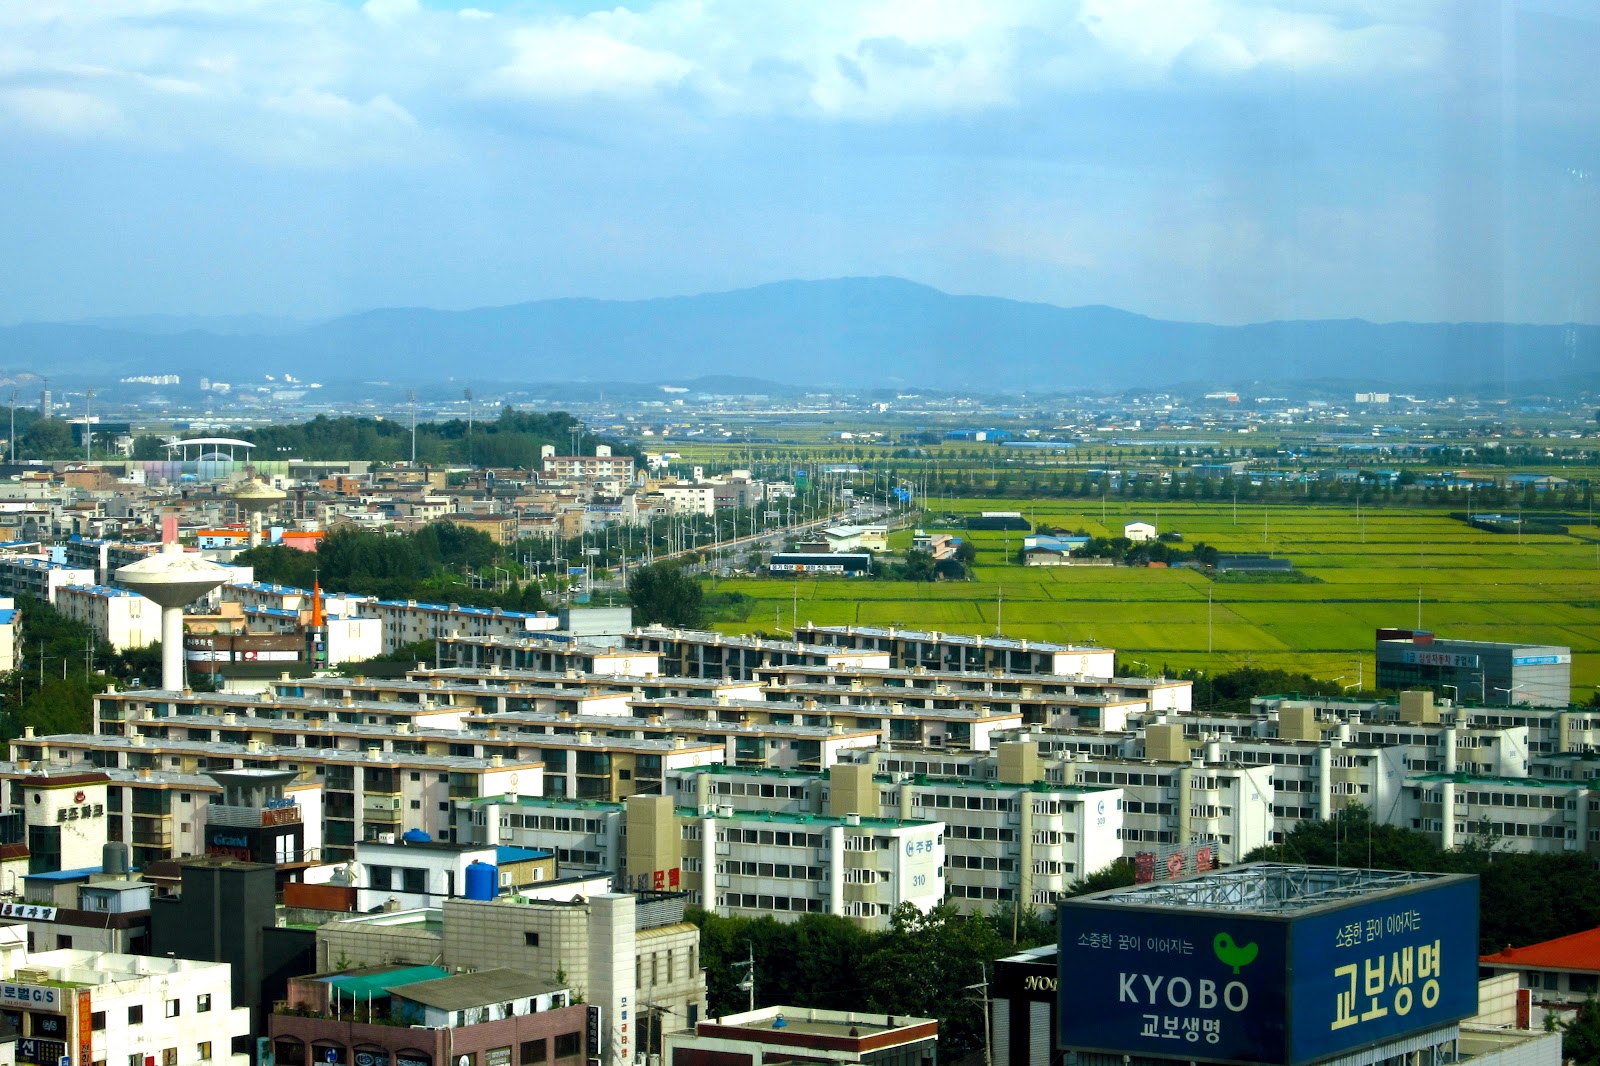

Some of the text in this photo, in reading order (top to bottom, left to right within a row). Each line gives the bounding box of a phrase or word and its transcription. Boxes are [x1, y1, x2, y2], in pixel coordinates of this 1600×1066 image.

[262, 807, 301, 826] MOTEL
[213, 833, 248, 847] Grand
[912, 874, 926, 887] 310
[1336, 909, 1421, 948] 소중한 꿈이 이어지는
[1077, 932, 1194, 955] 소중한 꿈이 이어지는
[0, 986, 54, 1002] 로벌 G/S
[1119, 972, 1249, 1012] KYOBO
[1331, 939, 1440, 1031] 교보생명
[1140, 1014, 1220, 1044] 교보생명
